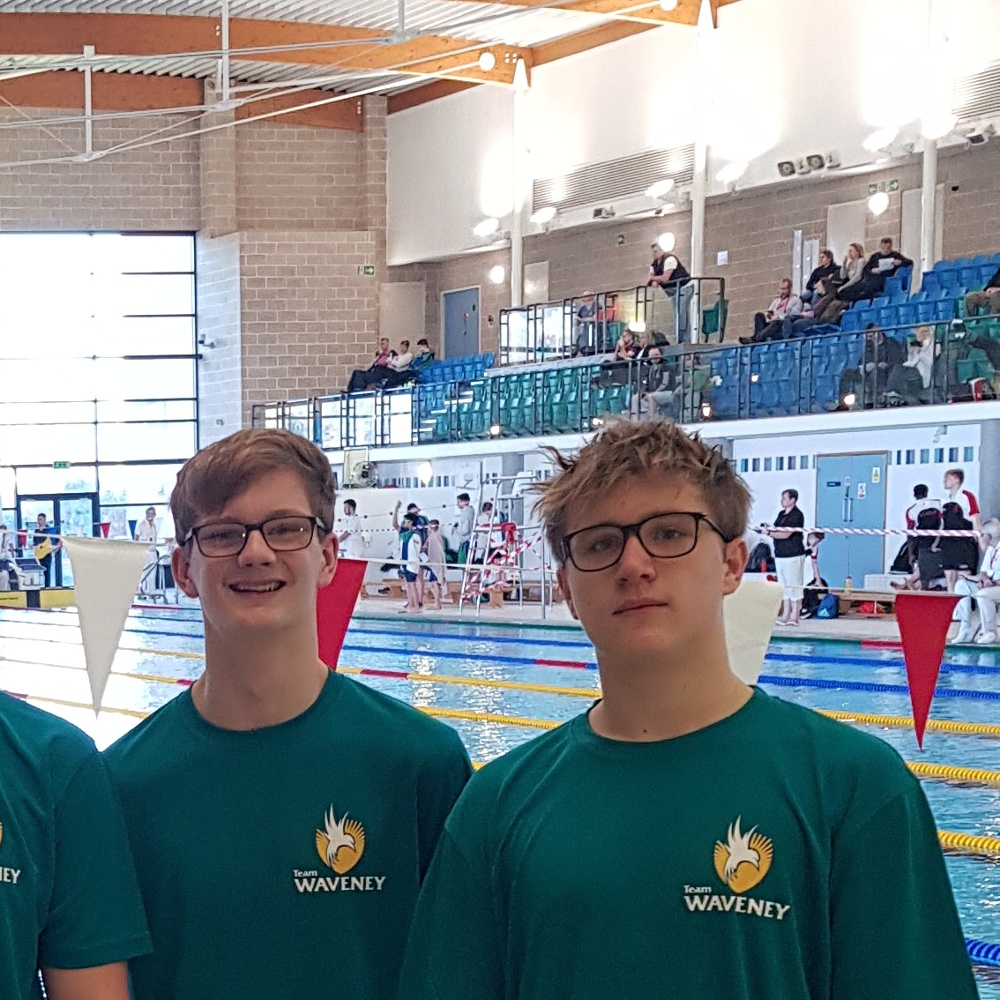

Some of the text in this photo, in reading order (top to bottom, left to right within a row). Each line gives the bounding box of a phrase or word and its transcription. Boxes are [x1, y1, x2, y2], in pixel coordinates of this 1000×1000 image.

[293, 869, 318, 877] Team
[293, 876, 387, 893] WAVENEY
[683, 885, 712, 894] Team
[683, 894, 791, 920] WAVENEY
